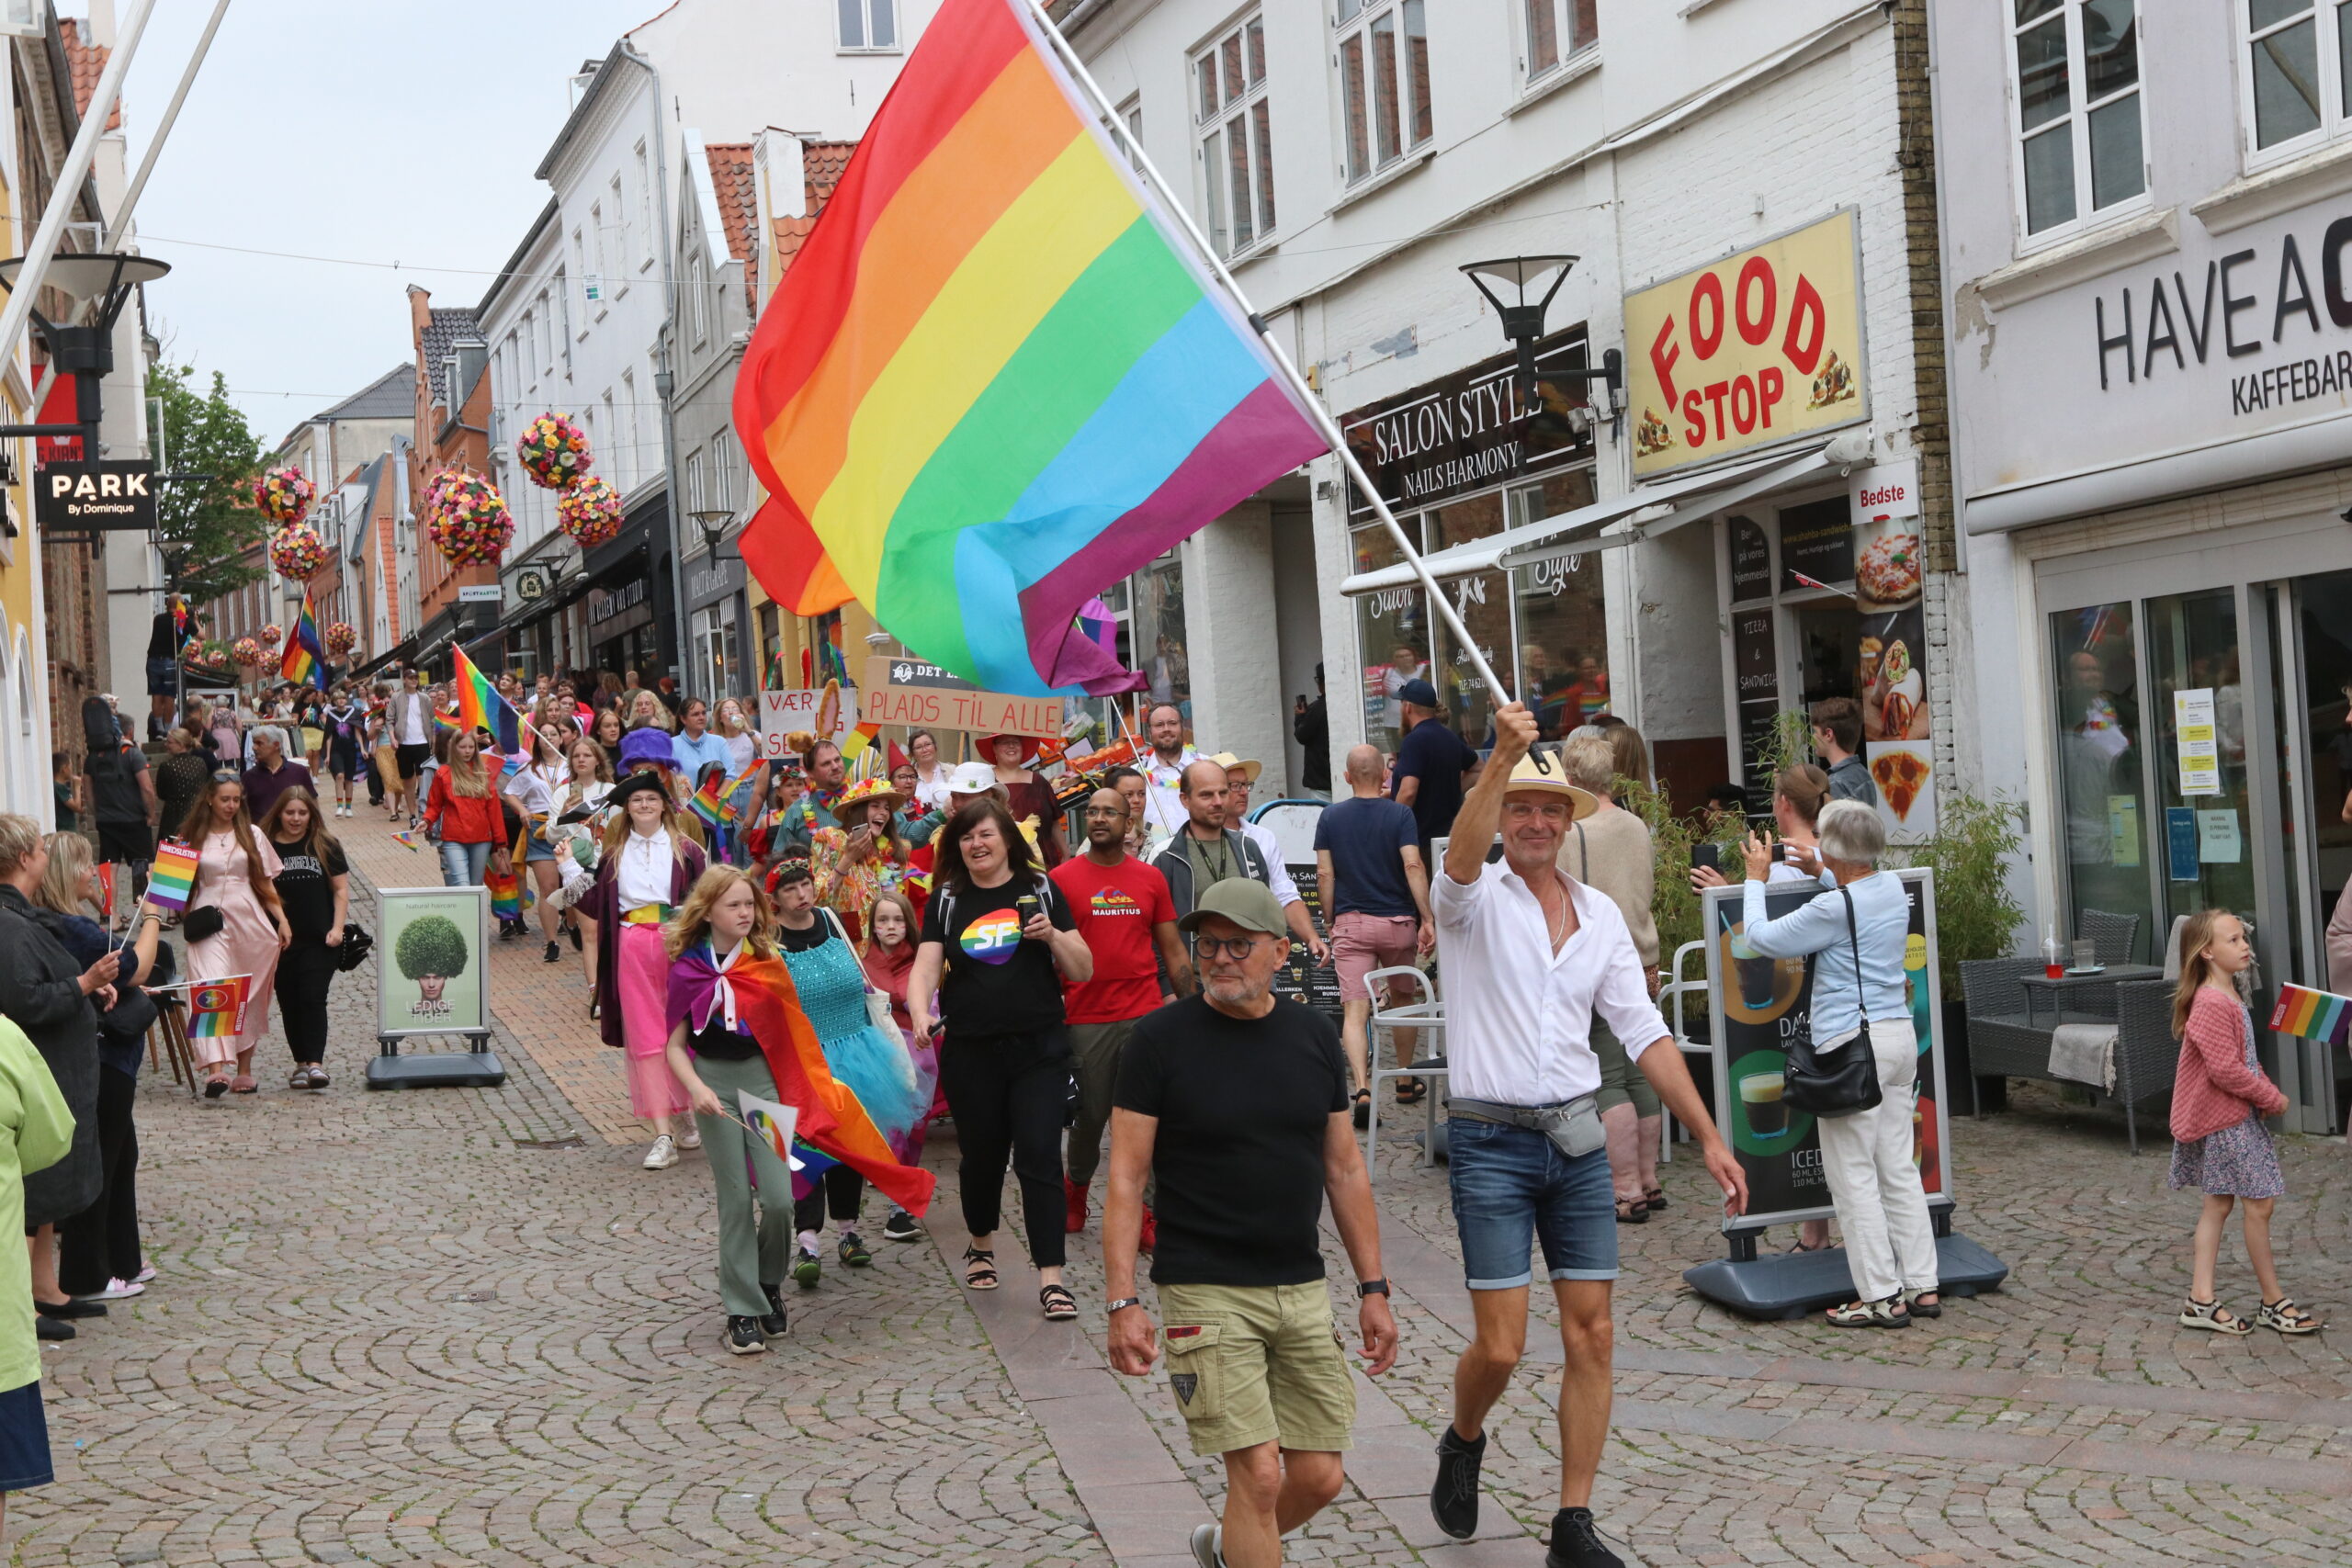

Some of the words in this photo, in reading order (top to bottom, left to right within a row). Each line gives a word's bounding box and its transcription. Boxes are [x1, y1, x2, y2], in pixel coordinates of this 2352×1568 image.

[2096, 248, 2261, 390] HAVE
[2273, 233, 2320, 343] A
[1649, 255, 1826, 413] FOOD
[1682, 367, 1784, 448] STOP
[1375, 397, 1454, 467] SALON
[1404, 459, 1445, 499] NAILS
[1446, 440, 1520, 488] HARMONY
[51, 473, 149, 501] PARK
[1860, 485, 1905, 507] Bedste
[68, 504, 82, 516] By
[84, 502, 135, 514] Dominique
[1738, 551, 1747, 564] på
[1747, 549, 1766, 559] vores
[1744, 619, 1768, 635] PIZZA
[917, 665, 942, 678] DET
[768, 692, 813, 711] VÆR
[869, 691, 941, 723] PLADS
[1000, 703, 1058, 734] ALLE
[1091, 908, 1141, 916] MAURITIUS
[974, 921, 1015, 950] SF
[1785, 965, 1794, 974] 90
[405, 999, 457, 1012] LEDIGE
[413, 1011, 452, 1024] TIDER
[1792, 1148, 1824, 1169] ICED
[1792, 1169, 1802, 1179] 60
[1793, 1179, 1805, 1188] 110
